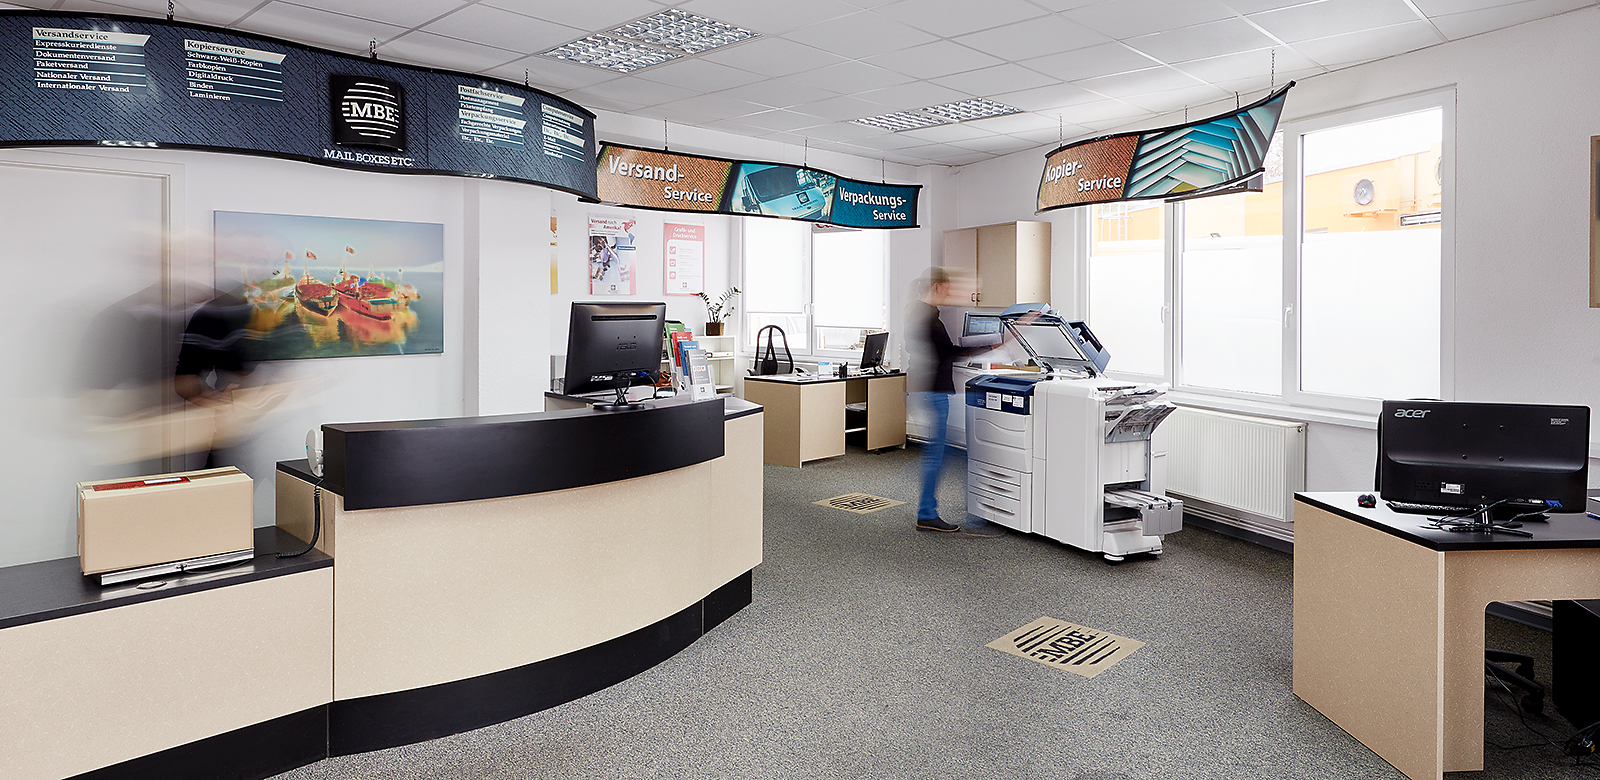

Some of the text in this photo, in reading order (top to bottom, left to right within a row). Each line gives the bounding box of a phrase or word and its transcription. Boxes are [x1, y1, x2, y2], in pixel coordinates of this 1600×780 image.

[36, 29, 108, 40] Versandservice
[36, 40, 117, 51] Expresskurierdienste
[187, 41, 246, 55] Kopierservice
[36, 51, 116, 61] Dokumentenversand
[187, 51, 263, 67] Schwarz-Weiß-Kopien
[36, 61, 88, 69] Paketversand
[188, 62, 226, 71] Farbkopien
[36, 71, 78, 79] Nationaler
[188, 71, 234, 81] Digitaldruck
[37, 82, 96, 90] Internationaler
[190, 91, 230, 100] Laminieren
[350, 102, 395, 122] MBE
[324, 149, 354, 160] MAIL
[356, 152, 390, 164] BOXES
[609, 155, 685, 182] Versand-
[1045, 159, 1082, 185] Kopier-
[1077, 174, 1122, 192] Service
[664, 186, 712, 202] Service
[839, 186, 906, 208] Verpackungs-
[874, 210, 907, 221] Service
[1394, 408, 1431, 419] acer
[1037, 630, 1096, 659] MBE
